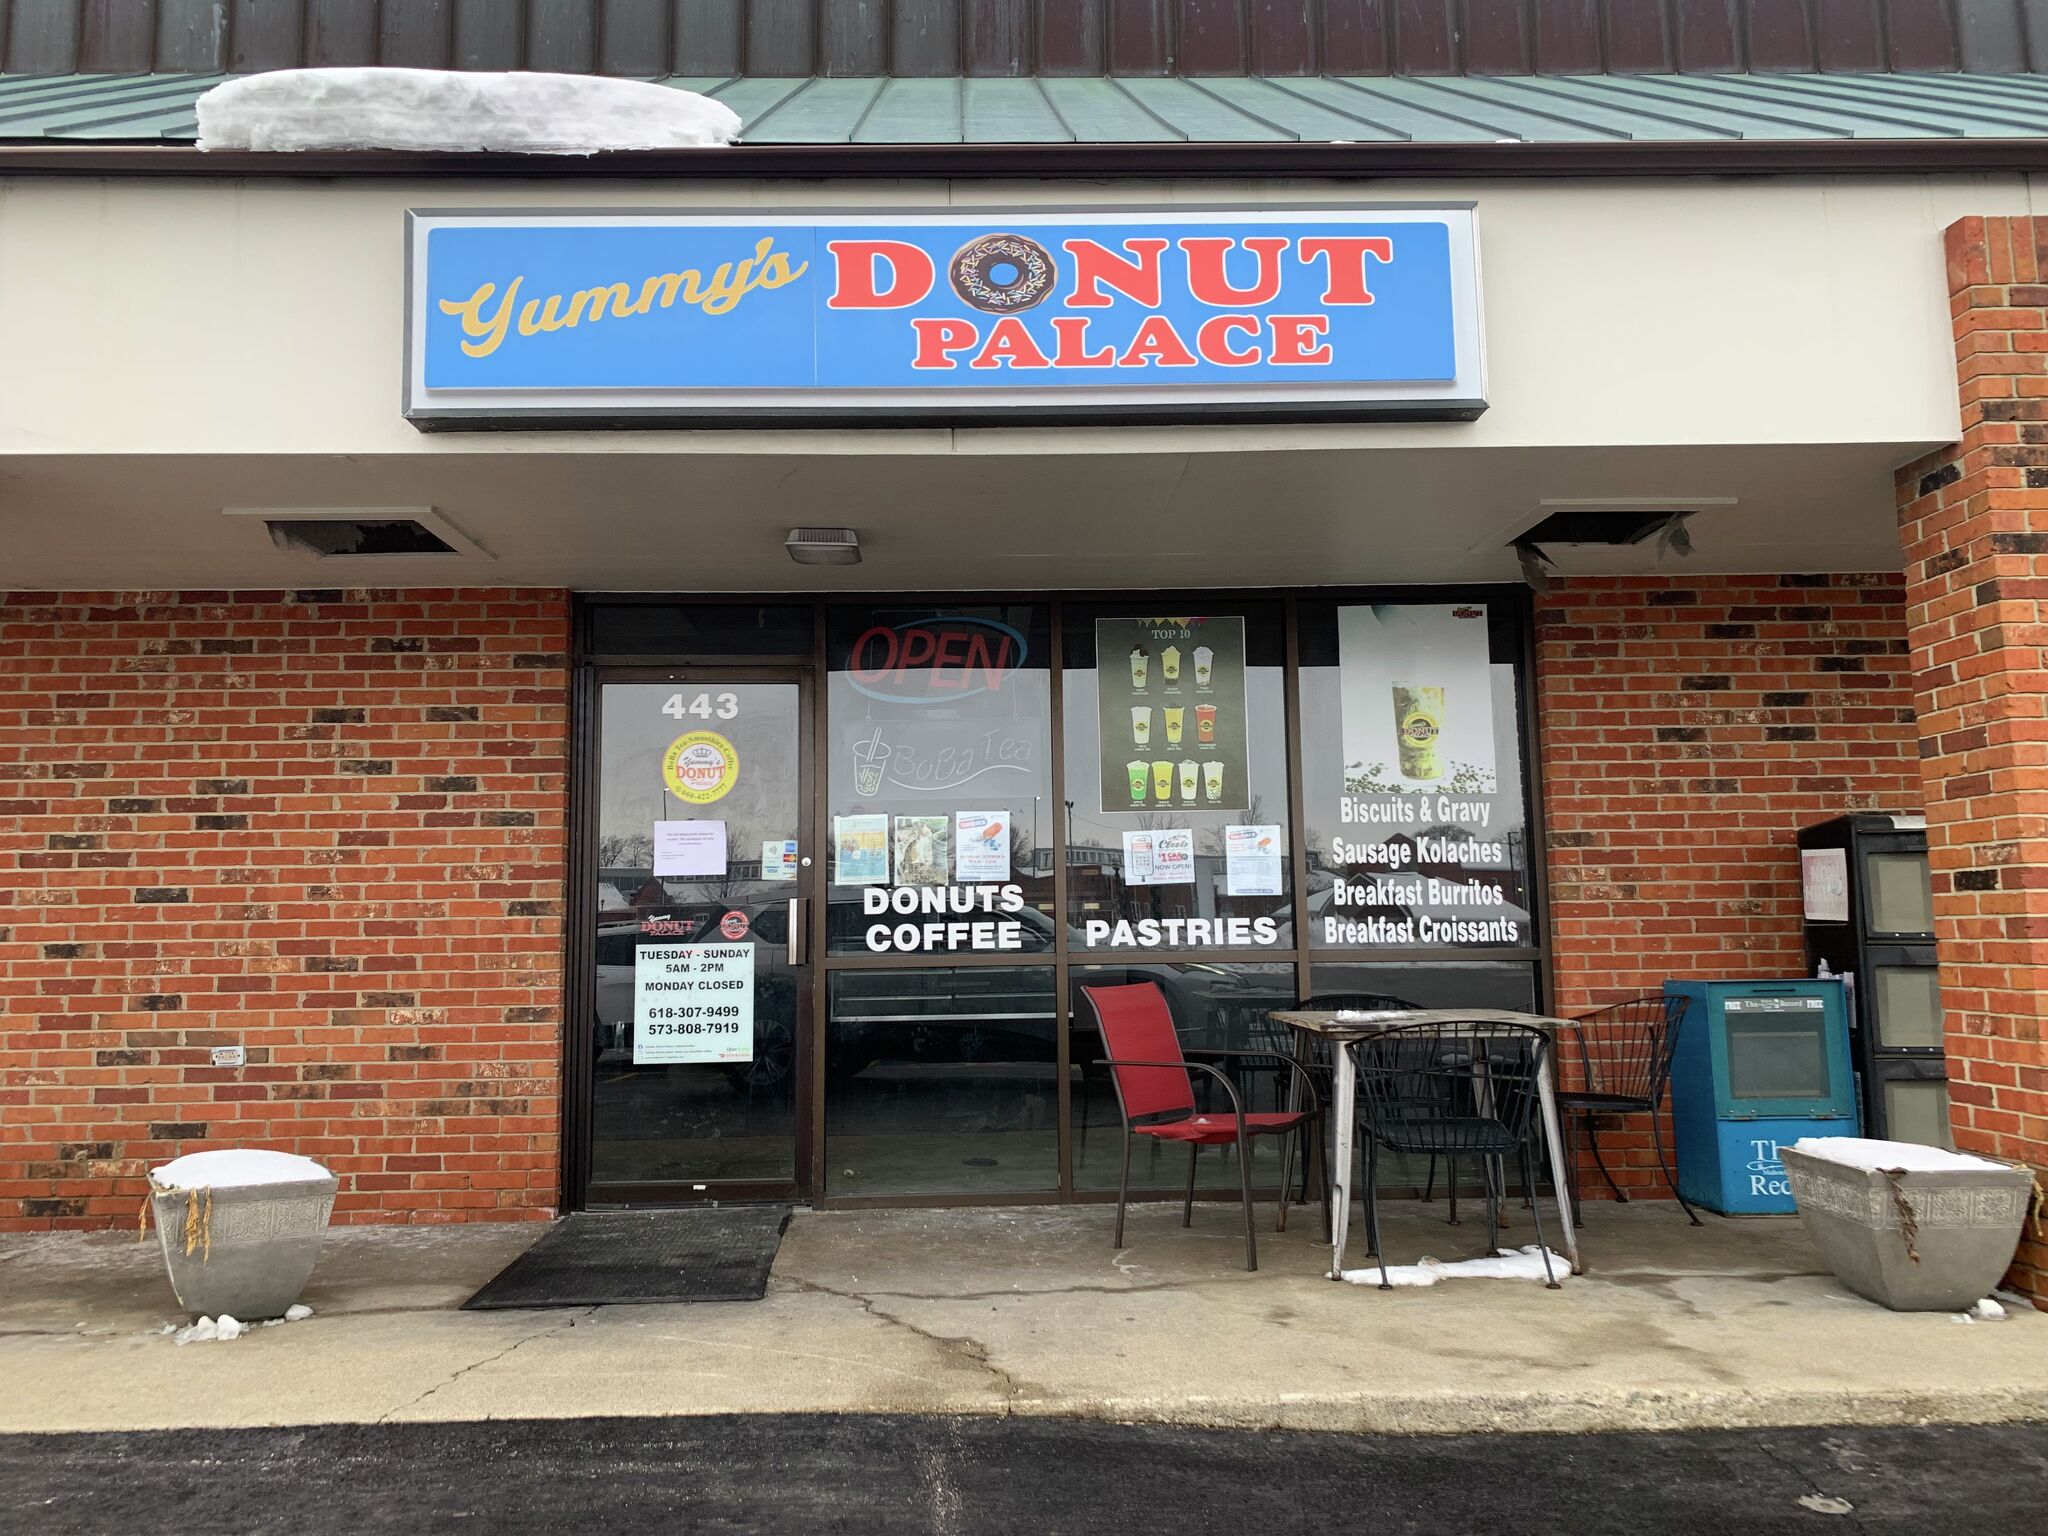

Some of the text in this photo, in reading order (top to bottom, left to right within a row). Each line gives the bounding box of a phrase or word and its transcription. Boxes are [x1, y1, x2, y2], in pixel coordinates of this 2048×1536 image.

[439, 236, 809, 358] Yummy's
[911, 315, 1332, 369] PALACE
[1151, 629, 1191, 640] TOP 10
[851, 626, 1012, 691] OPEN
[662, 693, 739, 720] 443
[983, 728, 1032, 762] Tea
[676, 765, 726, 779] DONUT
[1340, 795, 1490, 827] Biscuits & Gravy
[1332, 836, 1502, 869] Sausage Kolaches
[864, 884, 1025, 915] DONUTS
[1333, 878, 1504, 905] Breakfast Burritos
[641, 920, 695, 932] DONUT
[865, 921, 1022, 952] COFFEE
[1086, 917, 1278, 947] PASTRIES
[1324, 914, 1519, 943] Breakfast Croissants
[640, 950, 693, 960] TUESDAY
[703, 949, 751, 959] SUNDAY
[665, 964, 690, 973] 5AM
[700, 963, 724, 972] 2PM
[645, 980, 744, 991] MONDAY CLOSED
[649, 1006, 739, 1018] 618-307-9499
[648, 1022, 739, 1035] 573-808-7919
